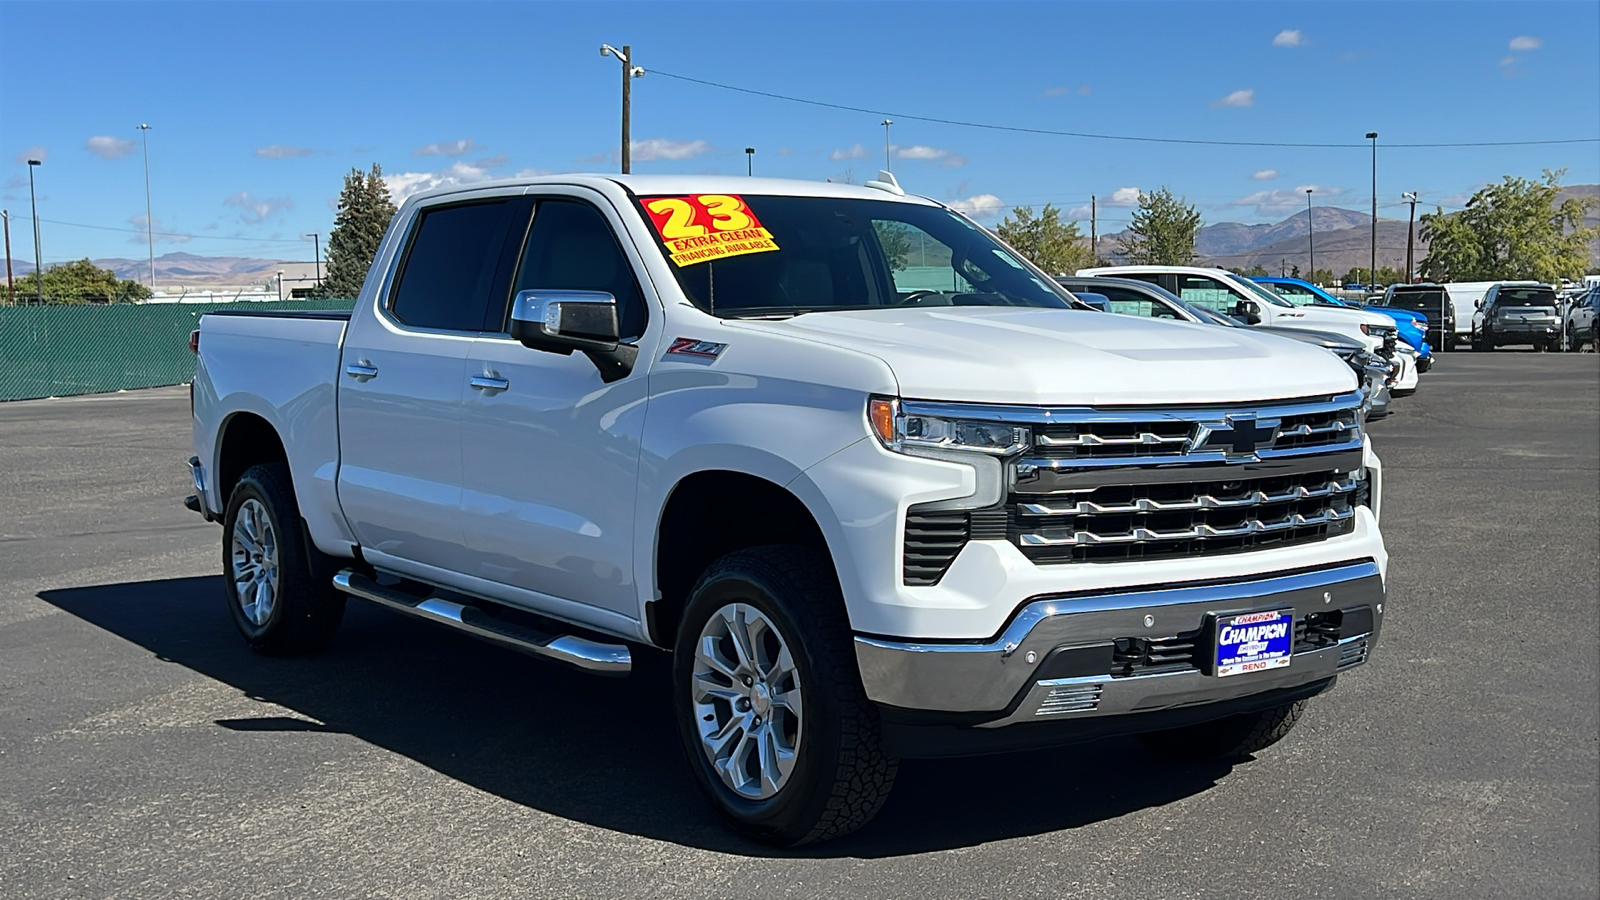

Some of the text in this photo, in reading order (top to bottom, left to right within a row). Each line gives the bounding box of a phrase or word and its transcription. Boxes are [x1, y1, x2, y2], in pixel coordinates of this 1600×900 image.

[648, 194, 755, 239] 23
[673, 229, 762, 251] EXTRA CLEAN
[673, 240, 774, 264] FINANCING AVAILABLE
[1238, 612, 1275, 624] CHAMPION
[1219, 622, 1288, 646] CHAMPION
[1242, 661, 1267, 671] RENO
